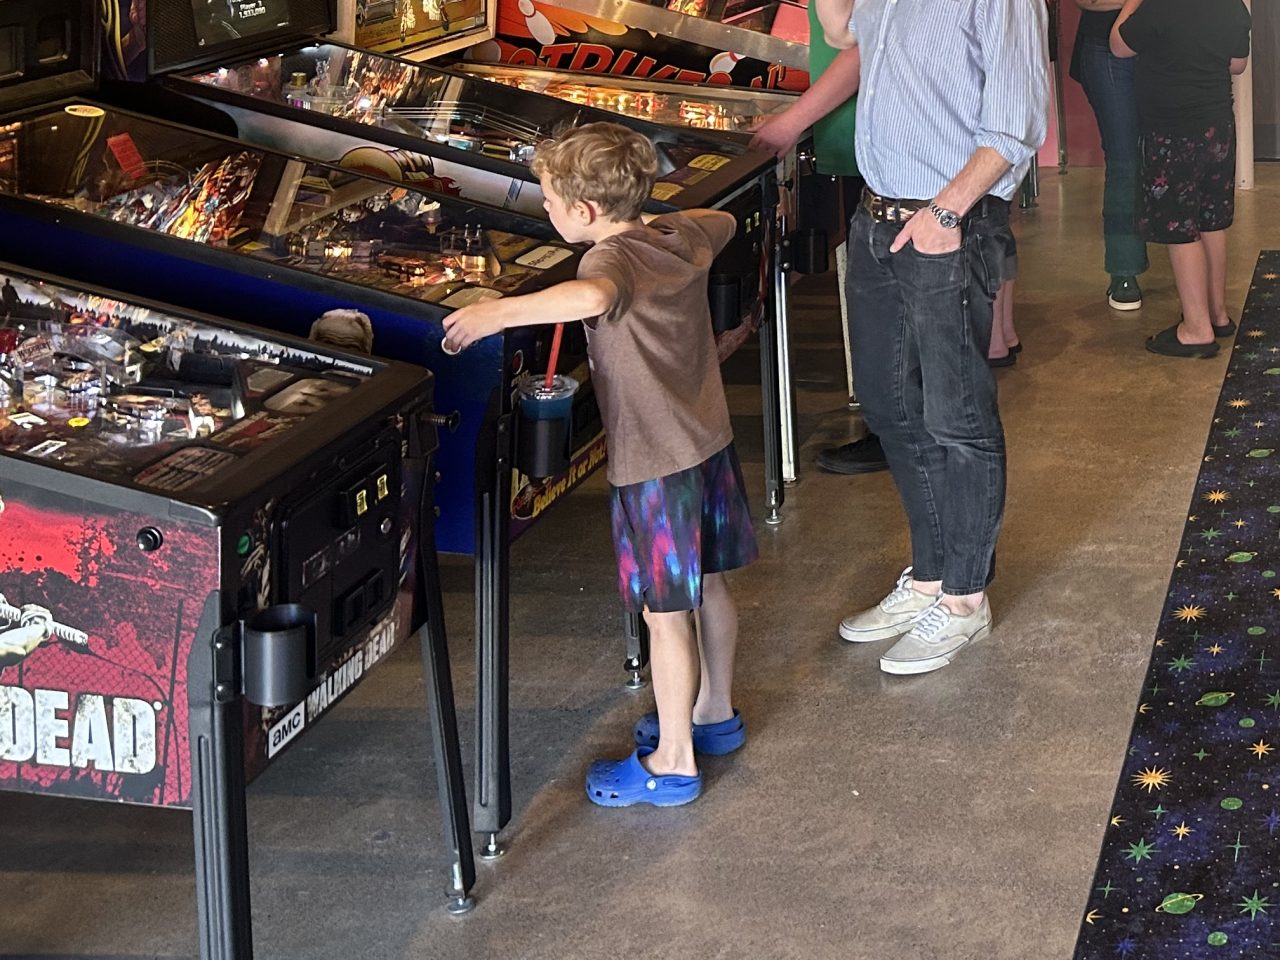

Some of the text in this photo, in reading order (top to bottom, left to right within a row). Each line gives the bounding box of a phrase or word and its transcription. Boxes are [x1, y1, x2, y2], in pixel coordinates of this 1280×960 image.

[532, 477, 567, 518] Believe
[577, 458, 589, 477] or
[307, 621, 396, 723] WALKING DEAD
[0, 685, 157, 776] DEAD
